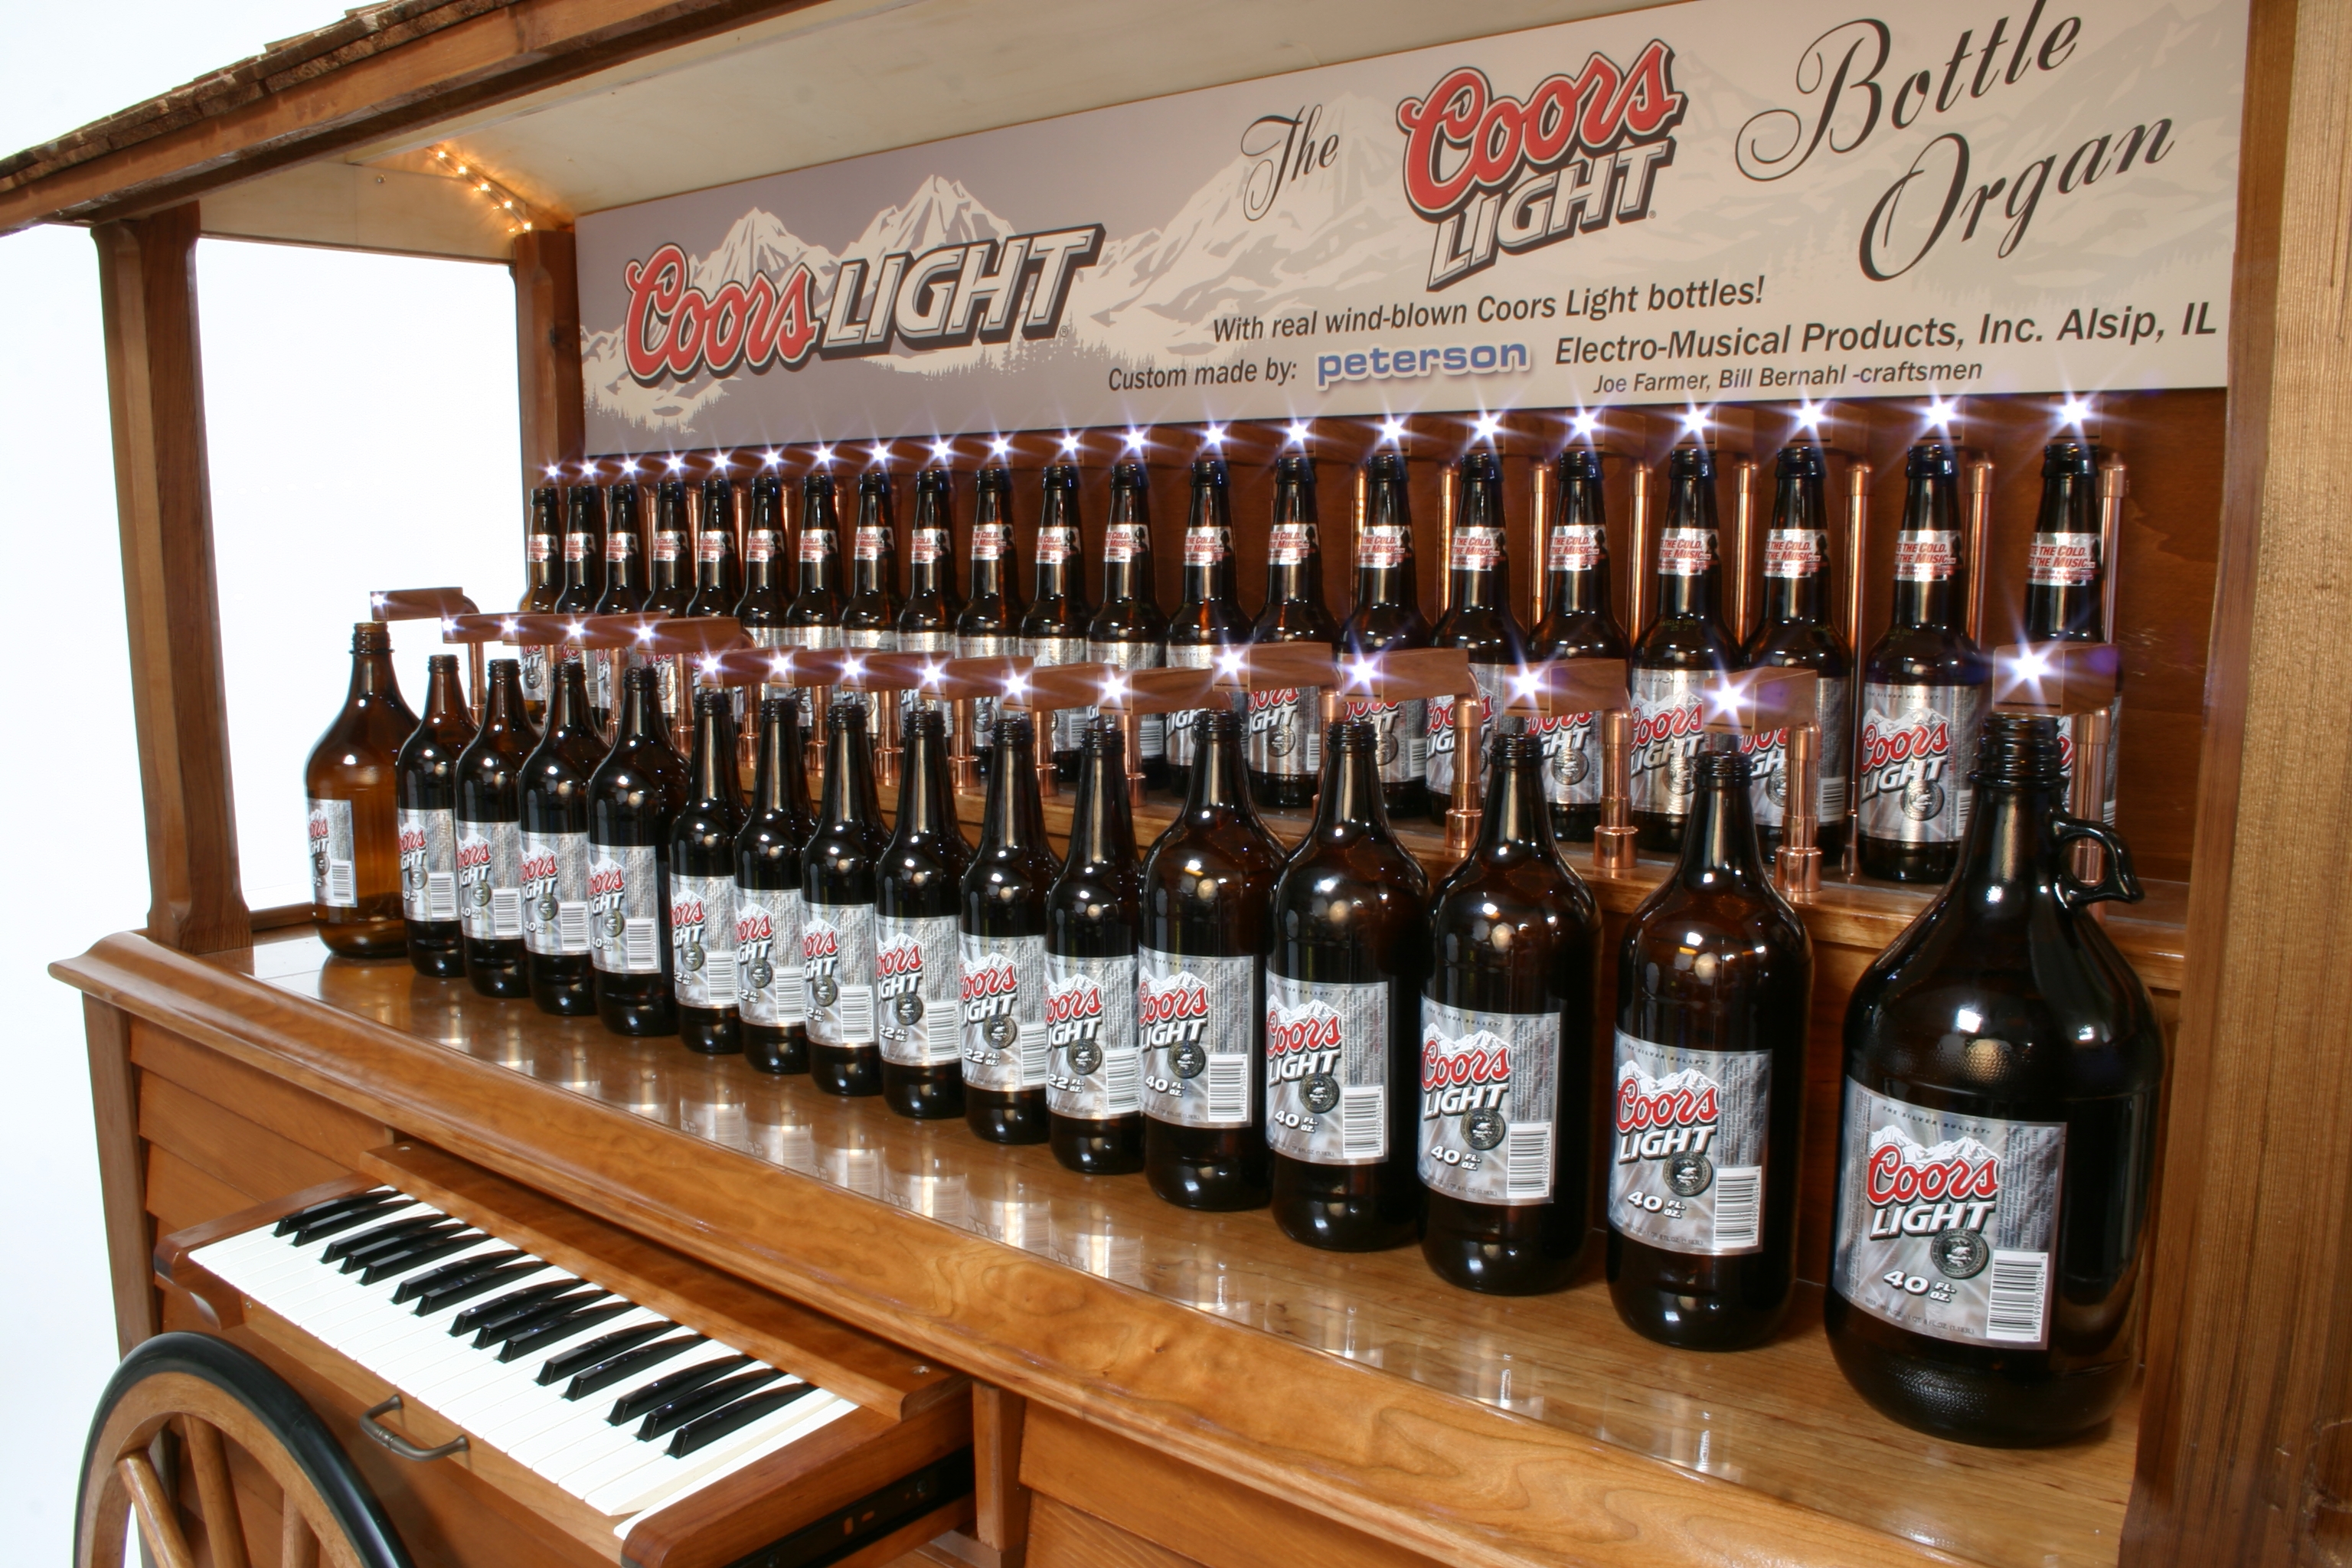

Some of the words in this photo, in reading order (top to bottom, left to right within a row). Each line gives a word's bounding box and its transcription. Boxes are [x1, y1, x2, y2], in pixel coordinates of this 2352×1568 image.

[1735, 0, 2082, 181] Bottle
[1396, 38, 1688, 221] Coors
[1240, 104, 1338, 221] The
[1426, 133, 1675, 292] LIGHT
[1859, 118, 2175, 282] Organ
[624, 243, 822, 387] Coors
[818, 223, 1106, 361] LIGHT
[1213, 316, 1265, 343] With
[1272, 316, 1317, 339] real
[1325, 301, 1468, 335] wind-blown
[1477, 294, 1556, 324] Coors
[1566, 286, 1637, 321] Light
[1647, 276, 1765, 311] bottles!
[1555, 325, 1790, 365] Electro-Musical
[1802, 317, 1965, 354] Products,
[1978, 312, 2044, 346] Inc.
[2057, 306, 2165, 346] Alsip,
[2180, 302, 2218, 337] IL
[1108, 361, 1188, 393] Custom
[1194, 360, 1258, 386] made
[1264, 360, 1298, 388] by:
[1316, 341, 1528, 389] peterson
[1593, 373, 1627, 396] Joe
[1633, 368, 1713, 394] Farmer,
[1718, 367, 1753, 390] Bill
[1759, 364, 1847, 387] Bernahl
[1852, 360, 1984, 384] -craftsmen
[2039, 546, 2056, 556] THE
[1860, 720, 1950, 773] Coors
[1860, 755, 1948, 805] LIGHT
[1266, 1008, 1342, 1060] Coors
[963, 1047, 985, 1063] 22
[1268, 1048, 1341, 1088] LIGHT
[1421, 1036, 1511, 1093] Coors
[1047, 1073, 1070, 1090] 22
[1145, 1074, 1169, 1093] 40
[1423, 1081, 1511, 1122] LIGHT
[1274, 1109, 1300, 1129] 40
[1302, 1116, 1320, 1127] FL.
[1615, 1075, 1720, 1135] Coors
[1902, 1112, 1938, 1126] SILVER
[1300, 1122, 1317, 1134] OZ.
[1618, 1123, 1718, 1165] LIGHT
[1430, 1144, 1462, 1167] 40
[1463, 1152, 1482, 1164] FL.
[1461, 1160, 1478, 1172] OZ.
[1867, 1141, 2001, 1207] Coors
[1627, 1190, 1664, 1213] 40
[1666, 1199, 1687, 1211] FL.
[1663, 1207, 1682, 1219] OZ.
[1869, 1200, 1997, 1241] LIGHT
[1883, 1269, 1930, 1296] 40
[1933, 1280, 1957, 1294] FL.
[1929, 1290, 1952, 1304] OZ.
